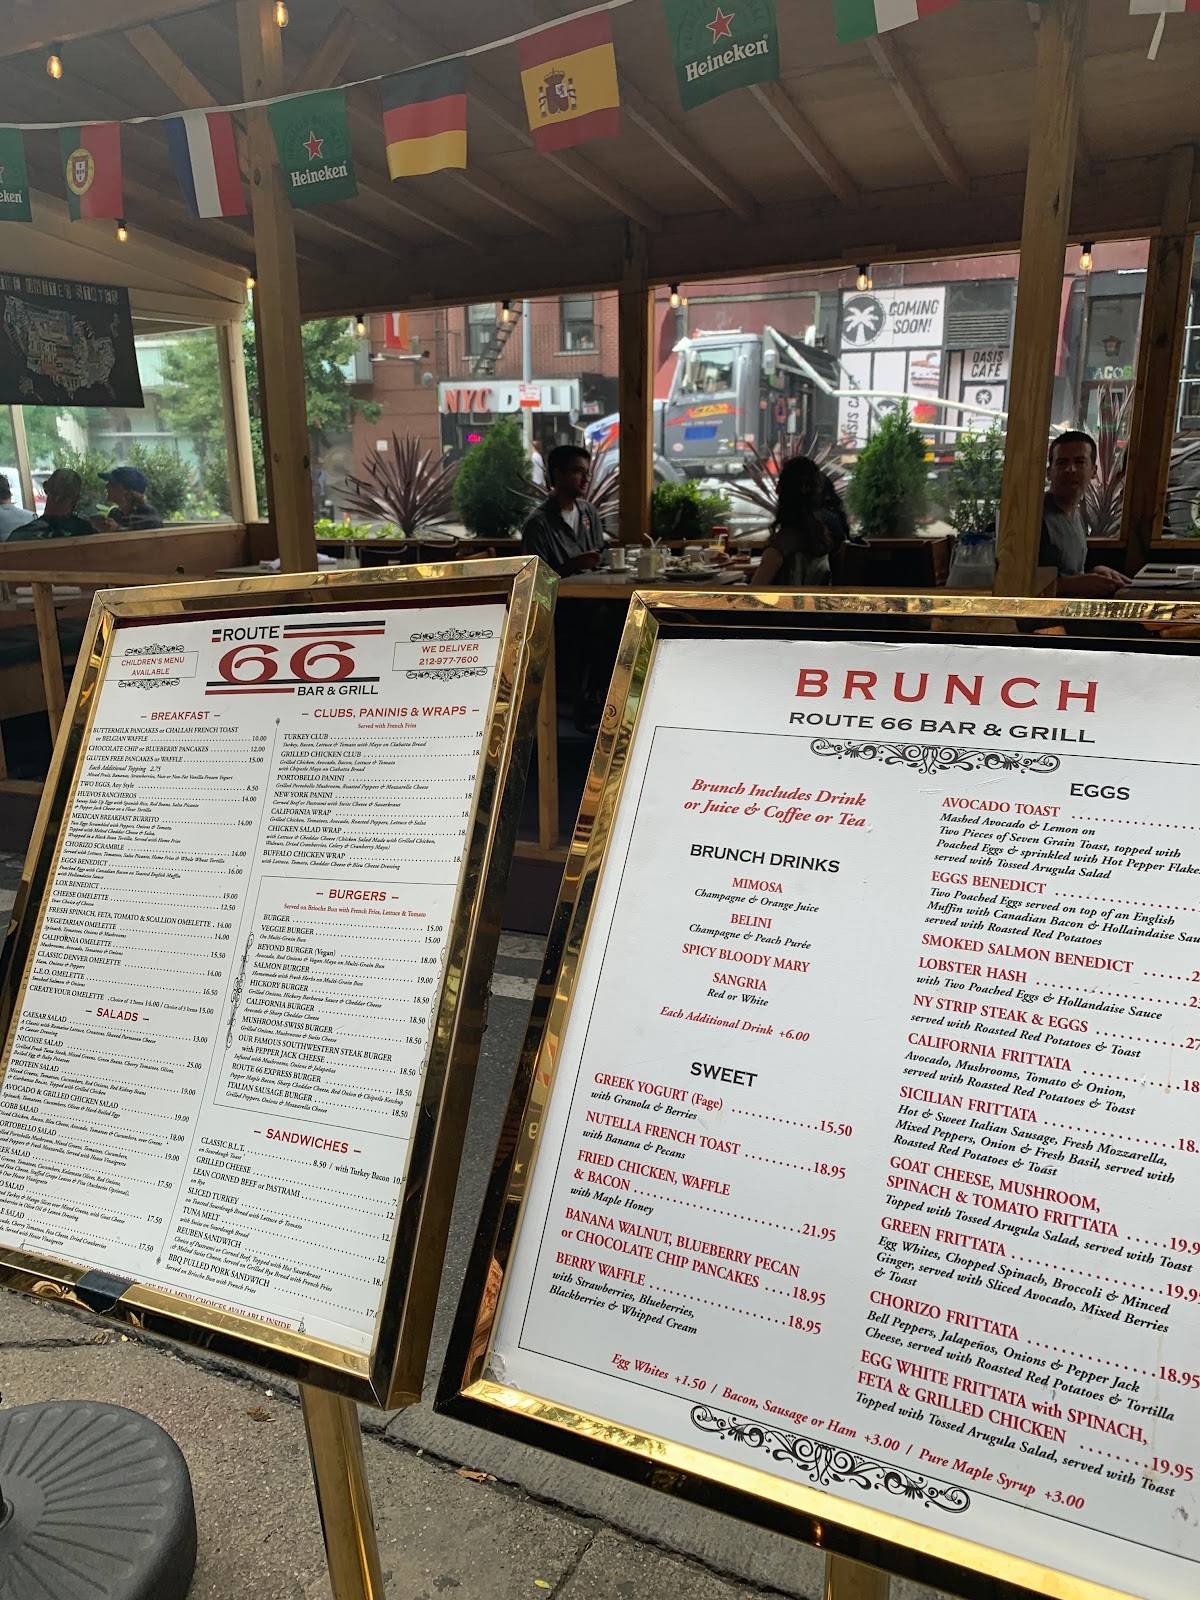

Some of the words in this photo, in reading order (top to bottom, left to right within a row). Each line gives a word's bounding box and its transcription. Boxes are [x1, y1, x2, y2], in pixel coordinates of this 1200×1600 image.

[685, 39, 769, 82] Heineken
[290, 164, 349, 187] Heineken
[0, 190, 23, 203] eken
[888, 300, 940, 317] COMING
[893, 318, 933, 334] SOON!
[972, 350, 1004, 364] OASIS
[971, 363, 1003, 378] CAFE
[444, 388, 492, 413] NYC
[499, 384, 574, 412] DLI
[222, 625, 280, 642] ROUTE
[421, 645, 437, 653] WE
[438, 643, 479, 653] DELIVER
[121, 658, 162, 666] CHILDREN'S
[218, 640, 356, 683] 66
[419, 656, 479, 666] 212-977-7600
[131, 668, 170, 676] AVAILABLE
[297, 686, 324, 696] BAR
[327, 686, 336, 695] &
[338, 685, 378, 695] GRILL
[795, 668, 1098, 713] BRUNCH
[151, 711, 210, 720] BREAKFAST
[314, 708, 356, 718] CLUBS,
[359, 707, 408, 717] PANINIS
[410, 707, 419, 717] &
[422, 706, 467, 716] WRAPS
[789, 712, 874, 729] ROUTE
[881, 717, 913, 731] 66
[920, 719, 976, 735] BAR
[983, 723, 1002, 737] &
[1009, 725, 1095, 743] GRILL
[691, 779, 746, 795] Brunch
[748, 784, 812, 801] Includes
[814, 790, 866, 806] Drink
[1070, 783, 1130, 800] EGGS
[684, 801, 701, 810] or
[699, 799, 740, 814] Juice
[744, 802, 761, 815] &
[764, 805, 812, 824] Coffee
[815, 815, 834, 823] or
[838, 812, 866, 827] Tea
[942, 797, 1011, 813] AVOCADO
[1014, 803, 1060, 817] TOAST
[940, 813, 981, 824] Mashed
[981, 817, 1025, 828] Avocado
[1029, 820, 1040, 830] &
[1042, 822, 1078, 834] Lemon
[77, 858, 108, 866] BENEDICT
[690, 844, 765, 864] BRUNCH
[770, 853, 840, 873] DRINKS
[732, 877, 783, 893] MIMOSA
[932, 871, 968, 885] EGGS
[972, 875, 1047, 894] BENEDICT
[329, 889, 387, 901] BURGERS
[694, 888, 746, 904] Champagne
[748, 895, 758, 904] &
[760, 897, 794, 911] Orange
[793, 902, 819, 912] Juice
[263, 914, 290, 922] BURGER
[730, 913, 772, 929] BELINI
[261, 924, 286, 933] VEGGIE
[287, 926, 314, 935] BURGER
[689, 923, 741, 940] Champagne
[743, 931, 753, 940] &
[754, 933, 782, 945] Peach
[682, 943, 717, 958] SPICY
[719, 949, 772, 966] BLOODY
[773, 957, 810, 972] MARY
[921, 934, 984, 952] SMOKED
[987, 943, 1051, 962] SALMON
[1055, 952, 1134, 973] BENEDICT
[253, 961, 282, 970] SALMON
[282, 964, 310, 973] BURGER
[918, 957, 982, 976] LOBSTER
[986, 967, 1027, 983] HASH
[712, 972, 766, 991] SANGRIA
[246, 997, 286, 1008] CALIFORNIA
[287, 1002, 315, 1011] BURGER
[707, 988, 726, 999] Red
[742, 994, 769, 1006] White
[22, 1010, 47, 1020] CAESAR
[47, 1014, 67, 1022] SALAD
[96, 1007, 139, 1022] SALADS
[913, 994, 934, 1007] NY
[936, 998, 977, 1014] STRIP
[980, 1005, 1028, 1023] STEAK
[1031, 1014, 1044, 1026] &
[1048, 1015, 1088, 1033] EGGS
[660, 1006, 684, 1018] Each
[685, 1011, 741, 1029] Additional
[741, 1021, 773, 1035] Drink
[779, 1029, 810, 1042] +6.00
[908, 1033, 996, 1058] CALIFORNIA
[1001, 1048, 1072, 1071] FRITTATA
[690, 1062, 758, 1087] SWEET
[594, 1072, 635, 1091] GREEK
[638, 1081, 689, 1102] YOGURT
[691, 1093, 723, 1111] (Fage)
[590, 1091, 611, 1101] with
[614, 1094, 651, 1110] Granola
[653, 1102, 663, 1112] &
[664, 1105, 697, 1120] Berries
[899, 1086, 963, 1108] SICILIAN
[968, 1098, 1037, 1123] FRITTATA
[586, 1110, 641, 1133] NUTELLA
[644, 1123, 696, 1145] FRENCH
[699, 1135, 741, 1155] TOAST
[820, 1120, 852, 1136] 15.50
[266, 1128, 349, 1154] SANDWICHES
[196, 1156, 225, 1167] GRILLED
[225, 1162, 251, 1173] CHEESE
[577, 1149, 614, 1168] FRIED
[617, 1159, 678, 1185] CHICKEN,
[682, 1173, 730, 1196] WAFFLE
[814, 1162, 846, 1179] 18.95
[574, 1168, 585, 1180] &
[587, 1171, 631, 1191] BACON
[176, 1226, 204, 1238] REUBEN
[203, 1233, 242, 1248] SANDWICH
[802, 1223, 836, 1242] 21.95
[881, 1217, 931, 1239] GREEN
[935, 1228, 1005, 1257] FRITTATA
[556, 1251, 596, 1272] BERRY
[598, 1262, 646, 1286] WAFFLE
[788, 1315, 821, 1335] 18.95
[870, 1290, 941, 1319] CHORIZO
[946, 1309, 1019, 1341] FRITTATA
